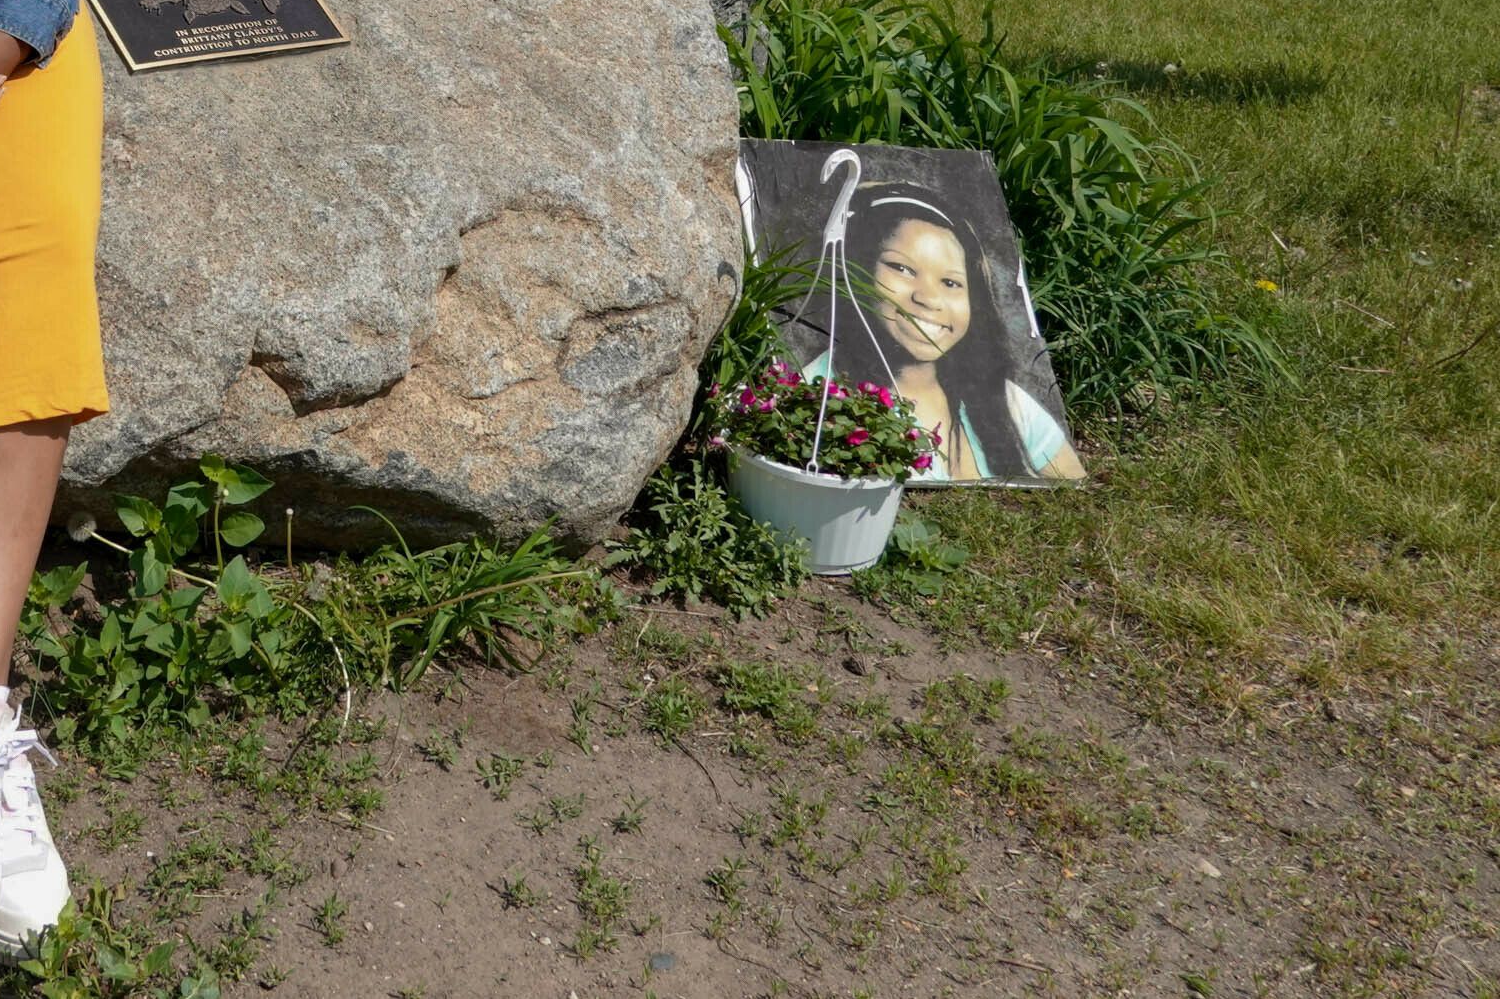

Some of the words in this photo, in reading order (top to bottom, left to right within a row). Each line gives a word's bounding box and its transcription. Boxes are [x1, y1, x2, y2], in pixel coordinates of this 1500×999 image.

[175, 29, 189, 38] IN
[192, 20, 262, 36] RECOGNITION
[265, 18, 279, 26] OF
[180, 33, 232, 45] BRITTANY
[234, 26, 284, 39] CLARDY'S
[154, 41, 233, 57] CONTRIBUTION
[235, 38, 251, 47] TO
[253, 34, 288, 44] NORTH
[291, 30, 319, 40] DALE
